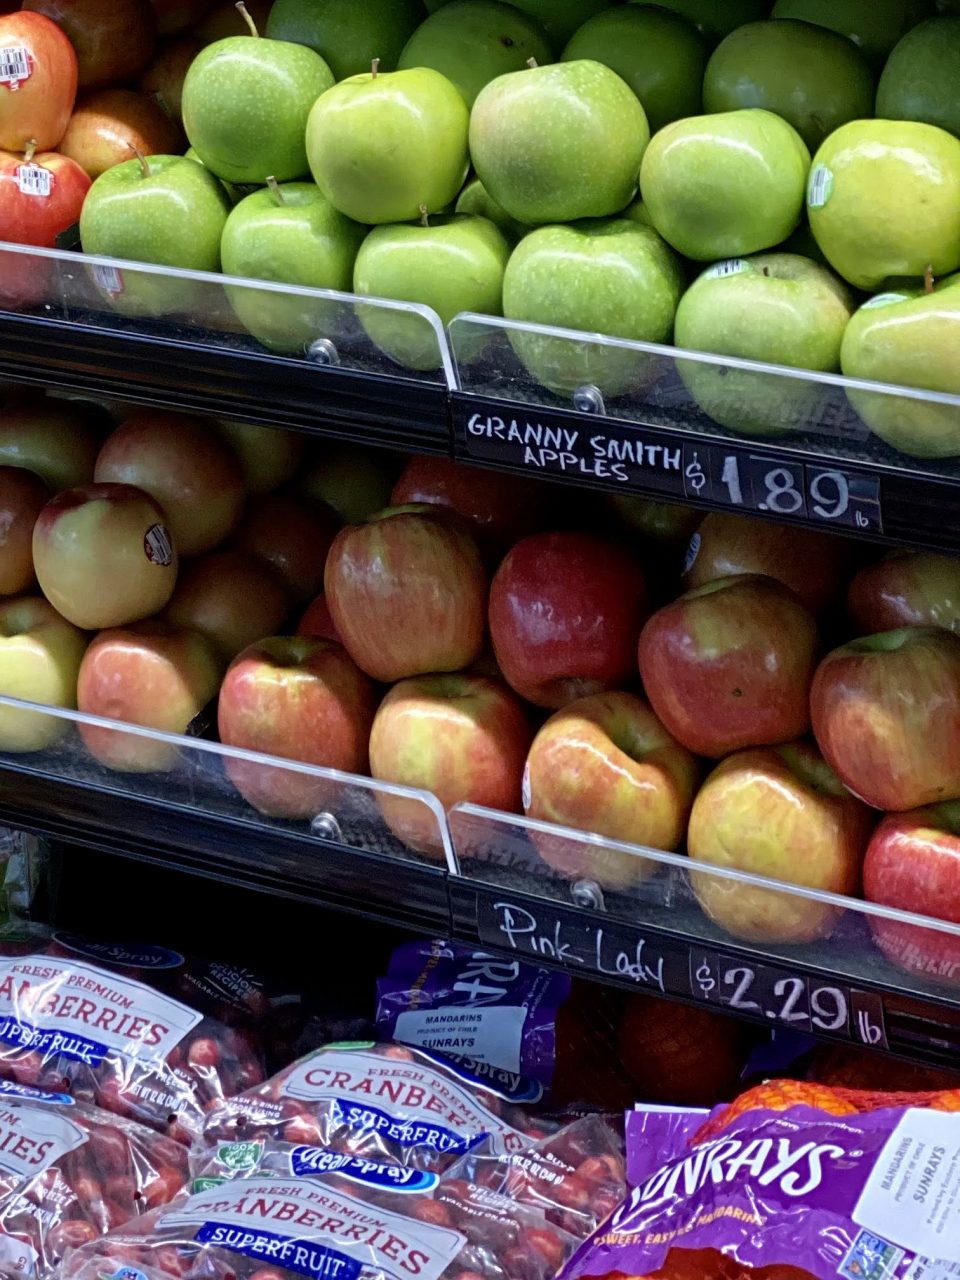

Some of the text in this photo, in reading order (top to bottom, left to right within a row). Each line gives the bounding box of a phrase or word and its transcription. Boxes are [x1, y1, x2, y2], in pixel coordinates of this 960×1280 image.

[467, 413, 681, 470] GRANNY SMITH
[524, 448, 629, 481] APPLES
[493, 902, 585, 964] Pink
[858, 1010, 882, 1045] lb
[425, 1013, 482, 1024] MANDARINS
[422, 1036, 476, 1048] SUNRAYS
[367, 1068, 426, 1082] FRESH
[463, 1057, 522, 1093] Spray
[350, 1157, 416, 1184] Spray
[881, 1137, 913, 1191] MANDARINS
[913, 1145, 946, 1204] SUNRAYS
[245, 1186, 303, 1197] FRESH
[306, 1191, 389, 1229] PREMIUM
[611, 1138, 844, 1235] SUNRAYS
[210, 1226, 345, 1279] SUPERFRUIT
